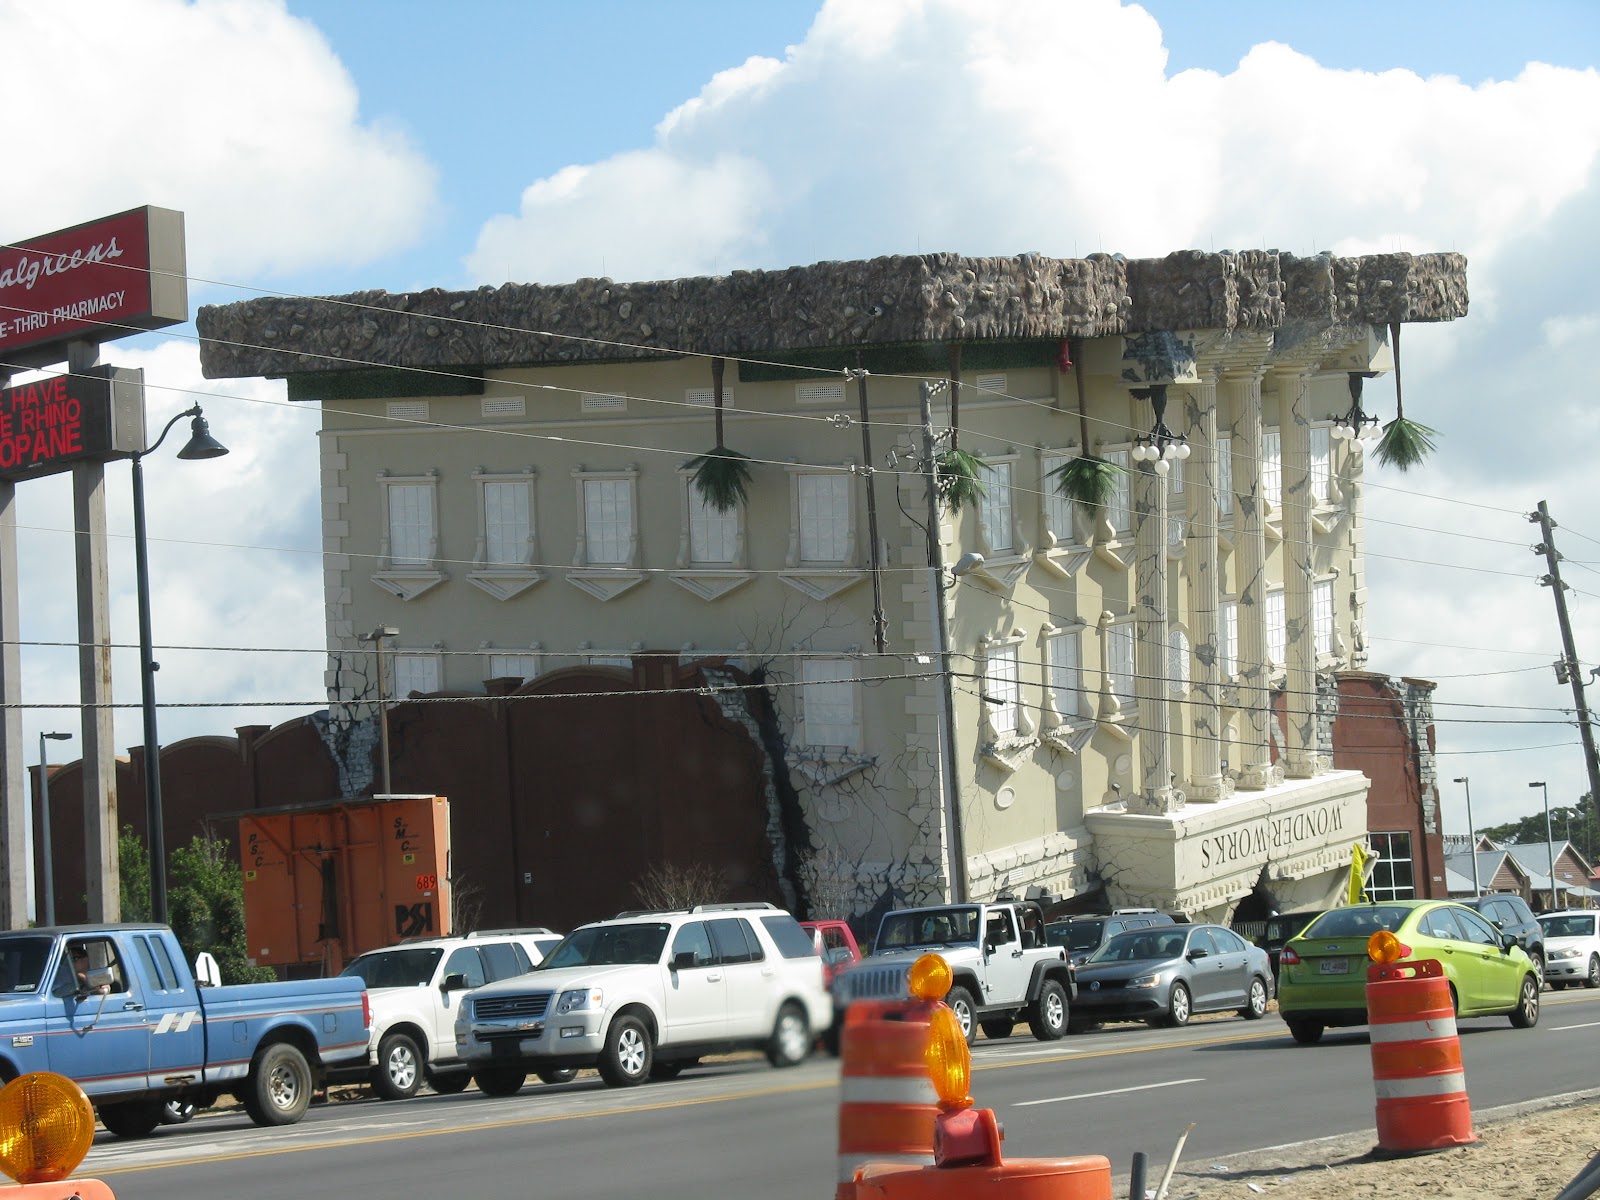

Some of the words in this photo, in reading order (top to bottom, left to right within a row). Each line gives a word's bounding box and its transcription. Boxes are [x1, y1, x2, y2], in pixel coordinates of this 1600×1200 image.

[53, 290, 126, 325] PHARMACY
[11, 376, 67, 413] HAVE
[21, 398, 81, 433] RHINO
[1201, 804, 1343, 870] WONDERWORKS
[416, 875, 436, 890] 689
